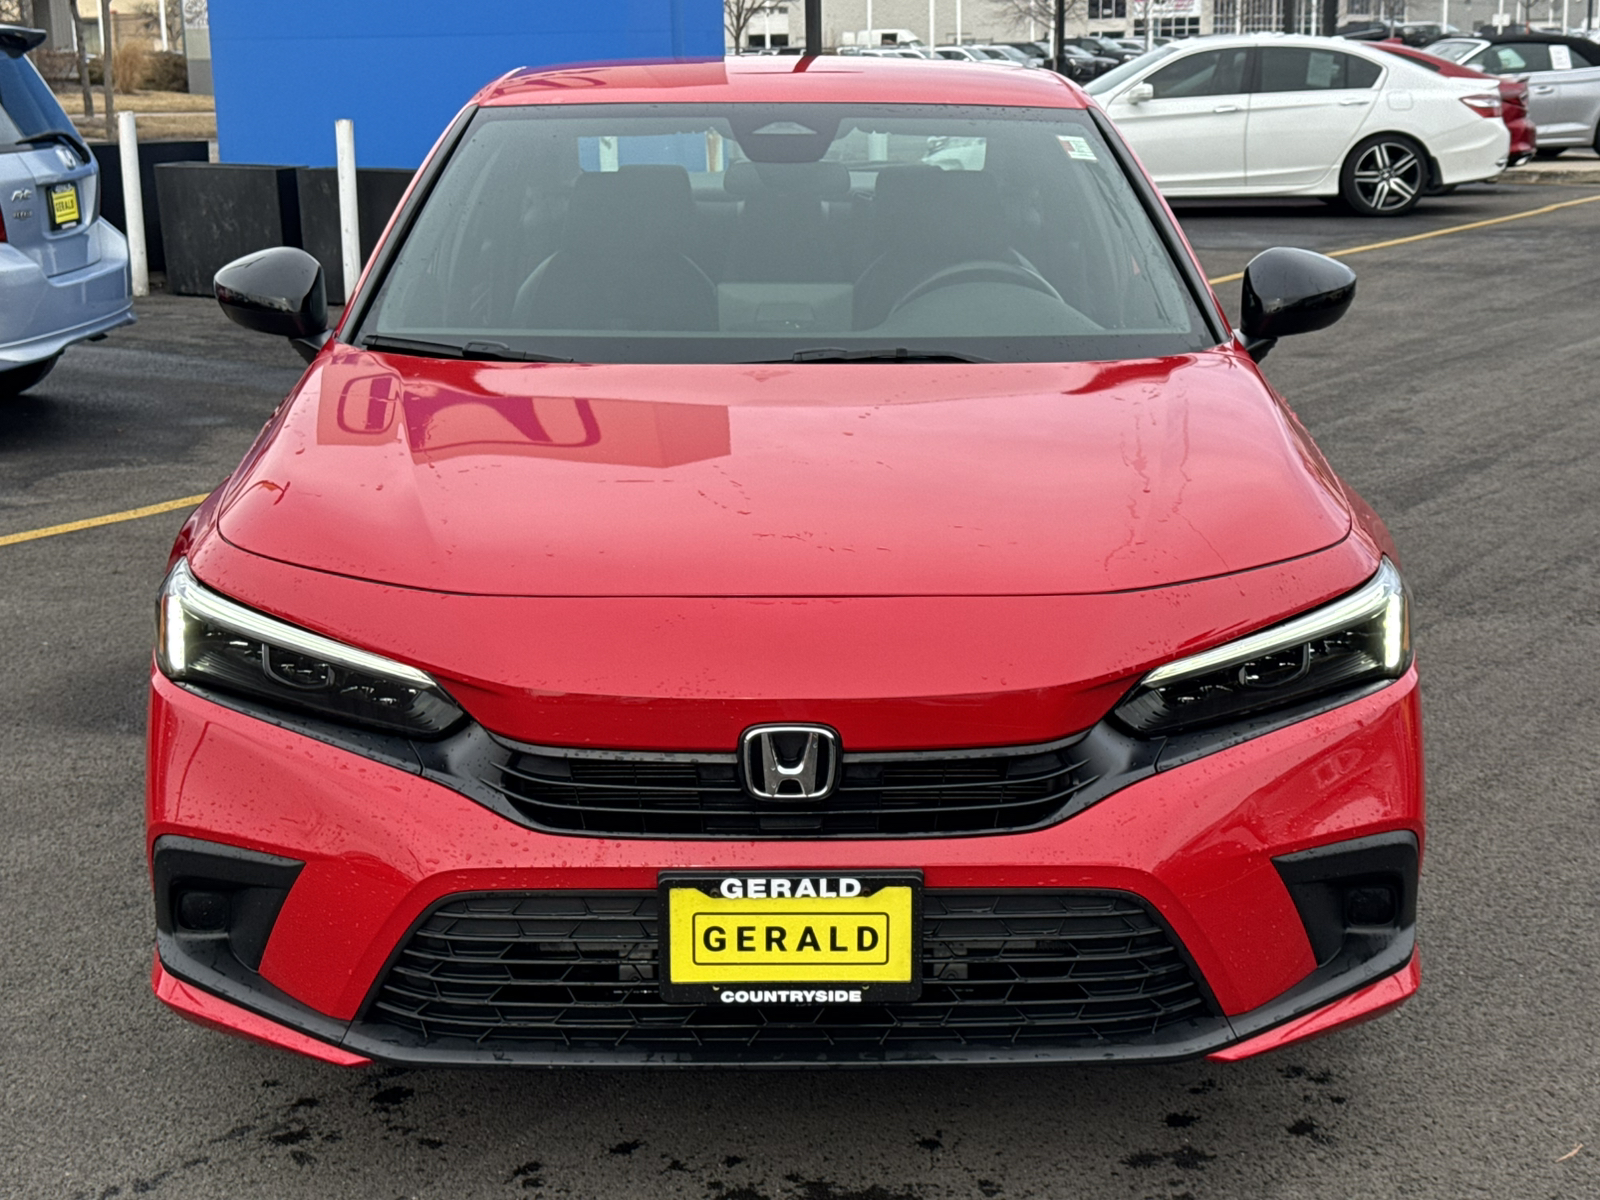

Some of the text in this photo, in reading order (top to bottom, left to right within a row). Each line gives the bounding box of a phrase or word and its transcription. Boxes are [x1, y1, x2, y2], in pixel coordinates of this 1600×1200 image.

[720, 878, 862, 899] GERALD
[703, 926, 879, 952] GERALD
[720, 990, 862, 1003] COUNTRYSIDE
